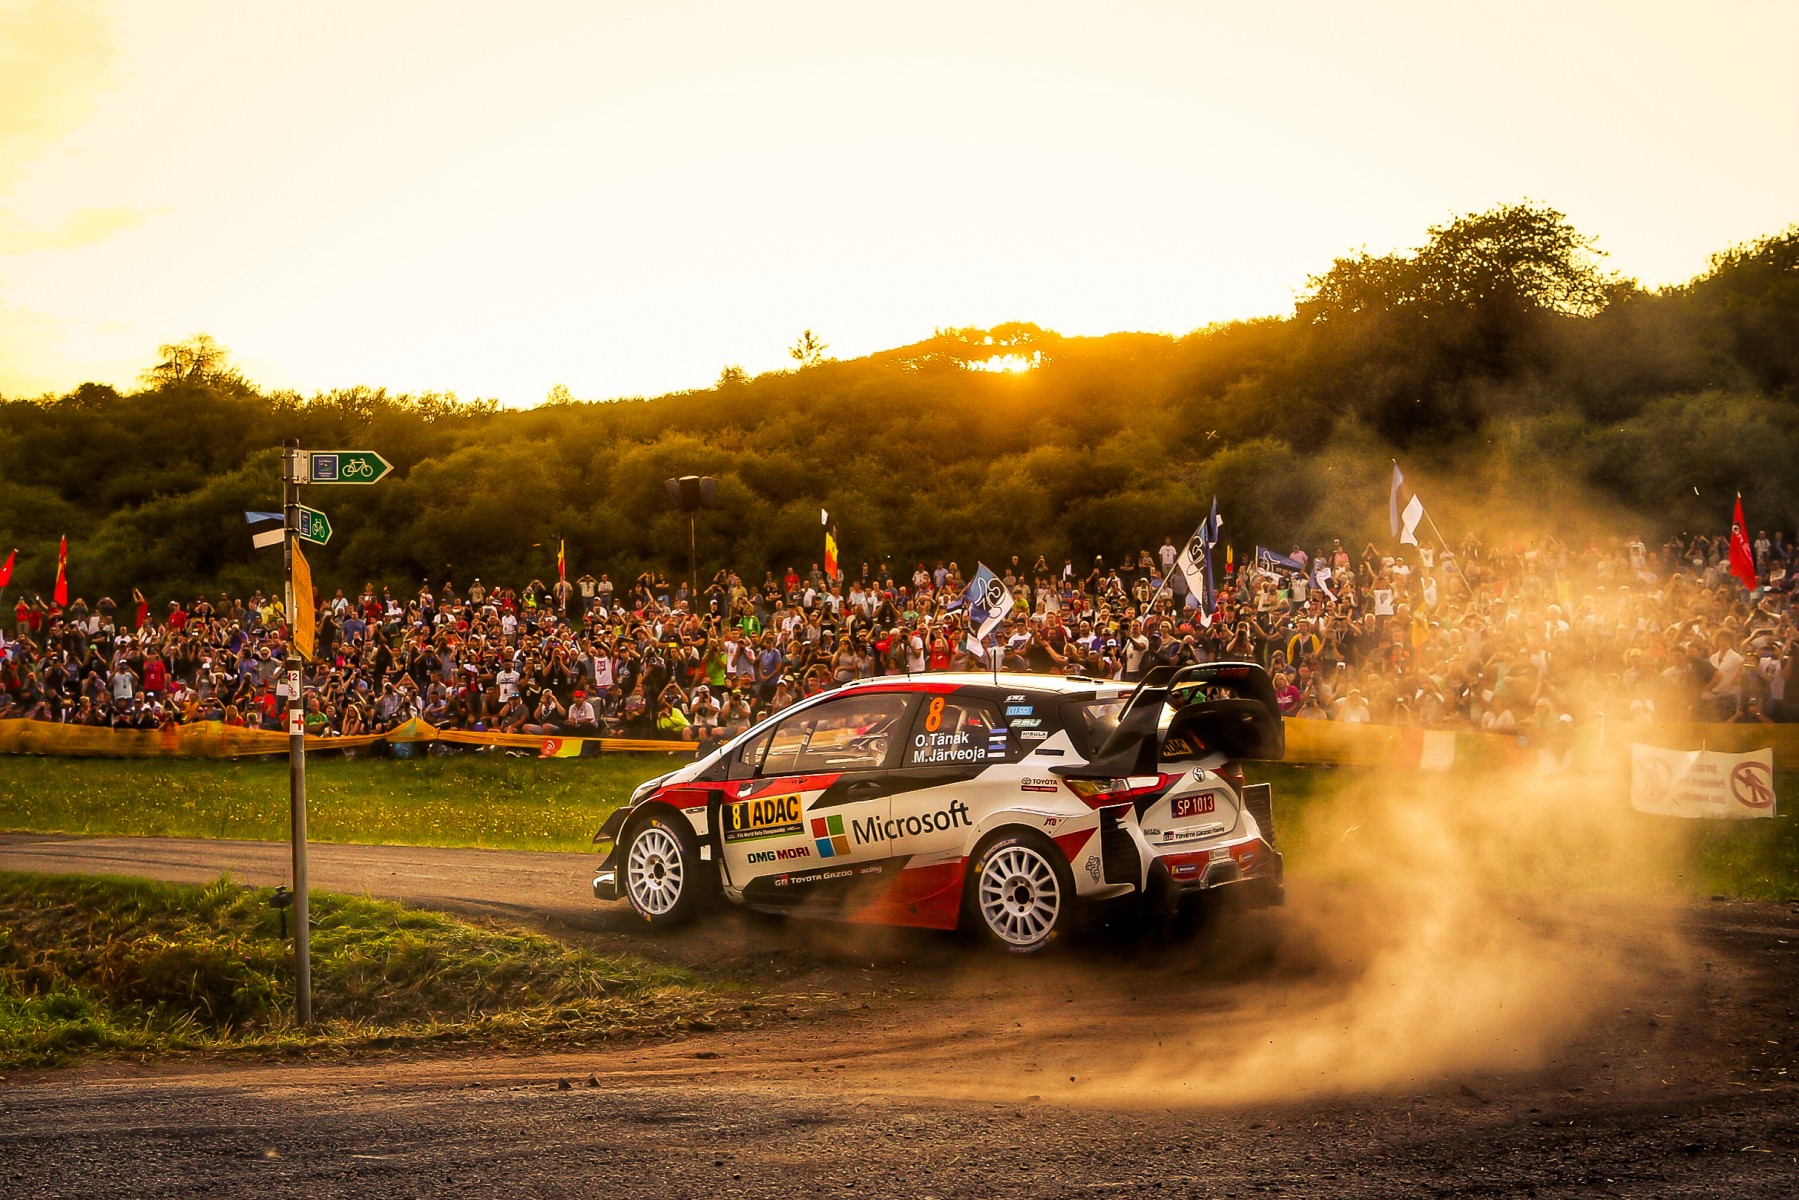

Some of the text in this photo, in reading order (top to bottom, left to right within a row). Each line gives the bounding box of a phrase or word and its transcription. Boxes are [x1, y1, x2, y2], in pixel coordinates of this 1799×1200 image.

[925, 696, 945, 732] 8
[915, 732, 970, 747] O.Tänak
[913, 746, 985, 763] M.Järveoja
[732, 796, 798, 830] 8 ADAC
[1177, 796, 1214, 816] SP 1013
[852, 800, 973, 845] Microsoft
[747, 846, 810, 864] DMG MORI
[790, 875, 822, 884] TOYOTA
[823, 870, 853, 879] GAZOO
